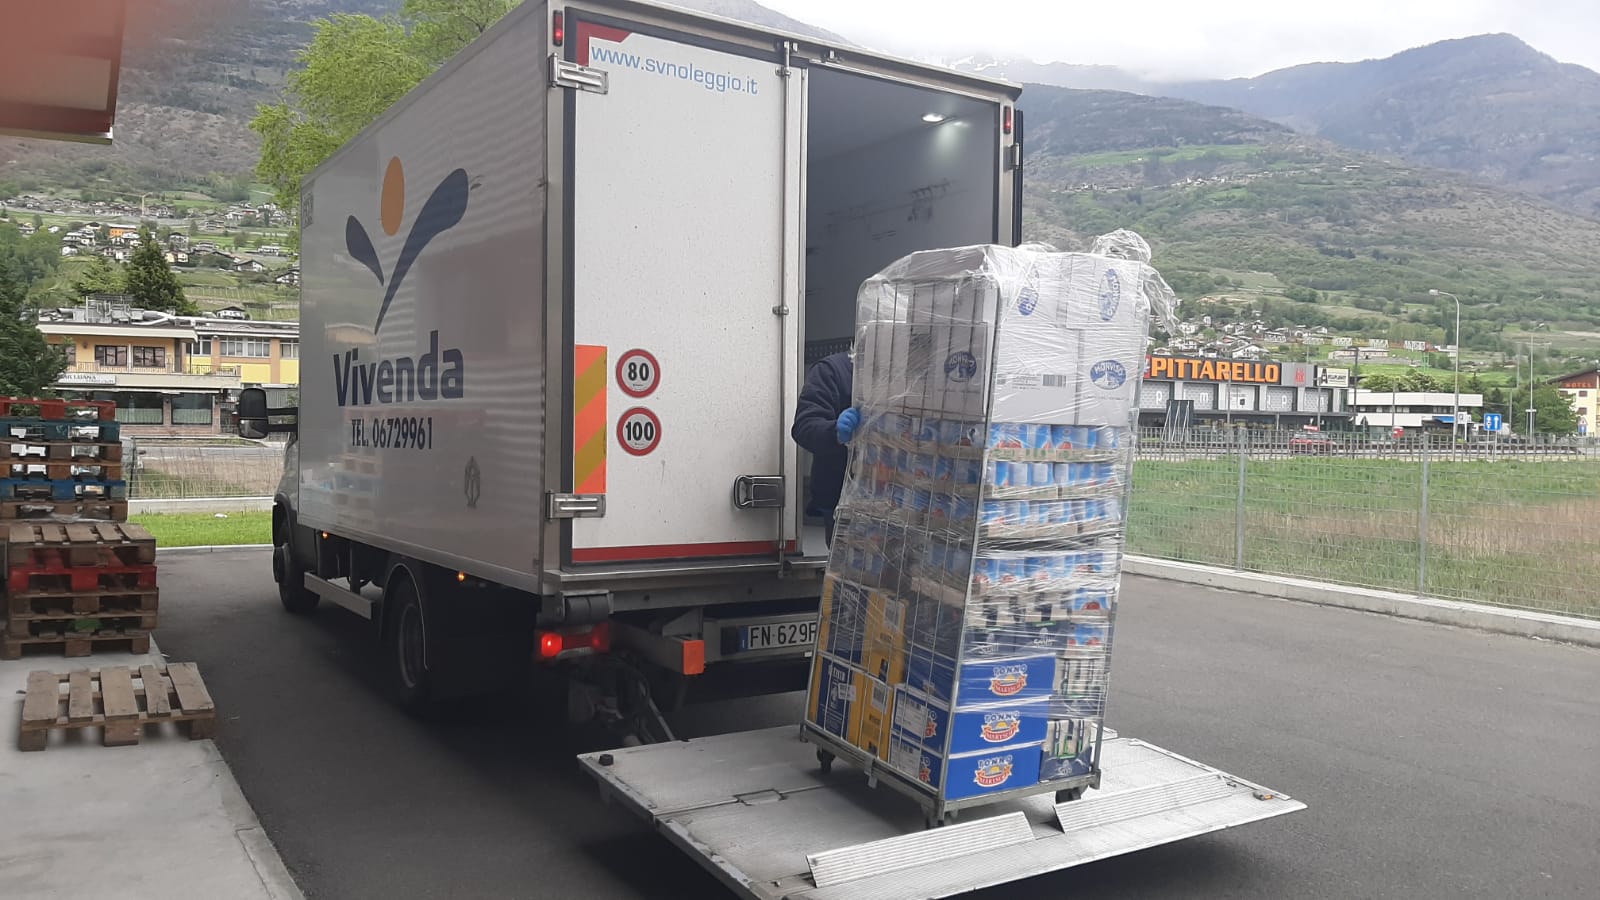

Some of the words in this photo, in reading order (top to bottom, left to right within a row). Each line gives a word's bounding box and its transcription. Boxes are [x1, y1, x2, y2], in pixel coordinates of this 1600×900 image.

[591, 46, 758, 95] www.svnoleggio.it
[333, 330, 464, 407] Vivenda
[628, 362, 650, 381] 80
[1151, 357, 1280, 383] PITTARELLO
[352, 418, 369, 447] TEL.
[372, 417, 432, 449] 06729961
[626, 421, 655, 441] 100
[750, 626, 771, 648] FN
[993, 664, 1028, 676] TONNO
[984, 710, 1020, 723] TONNO
[977, 755, 1013, 768] TONNO
